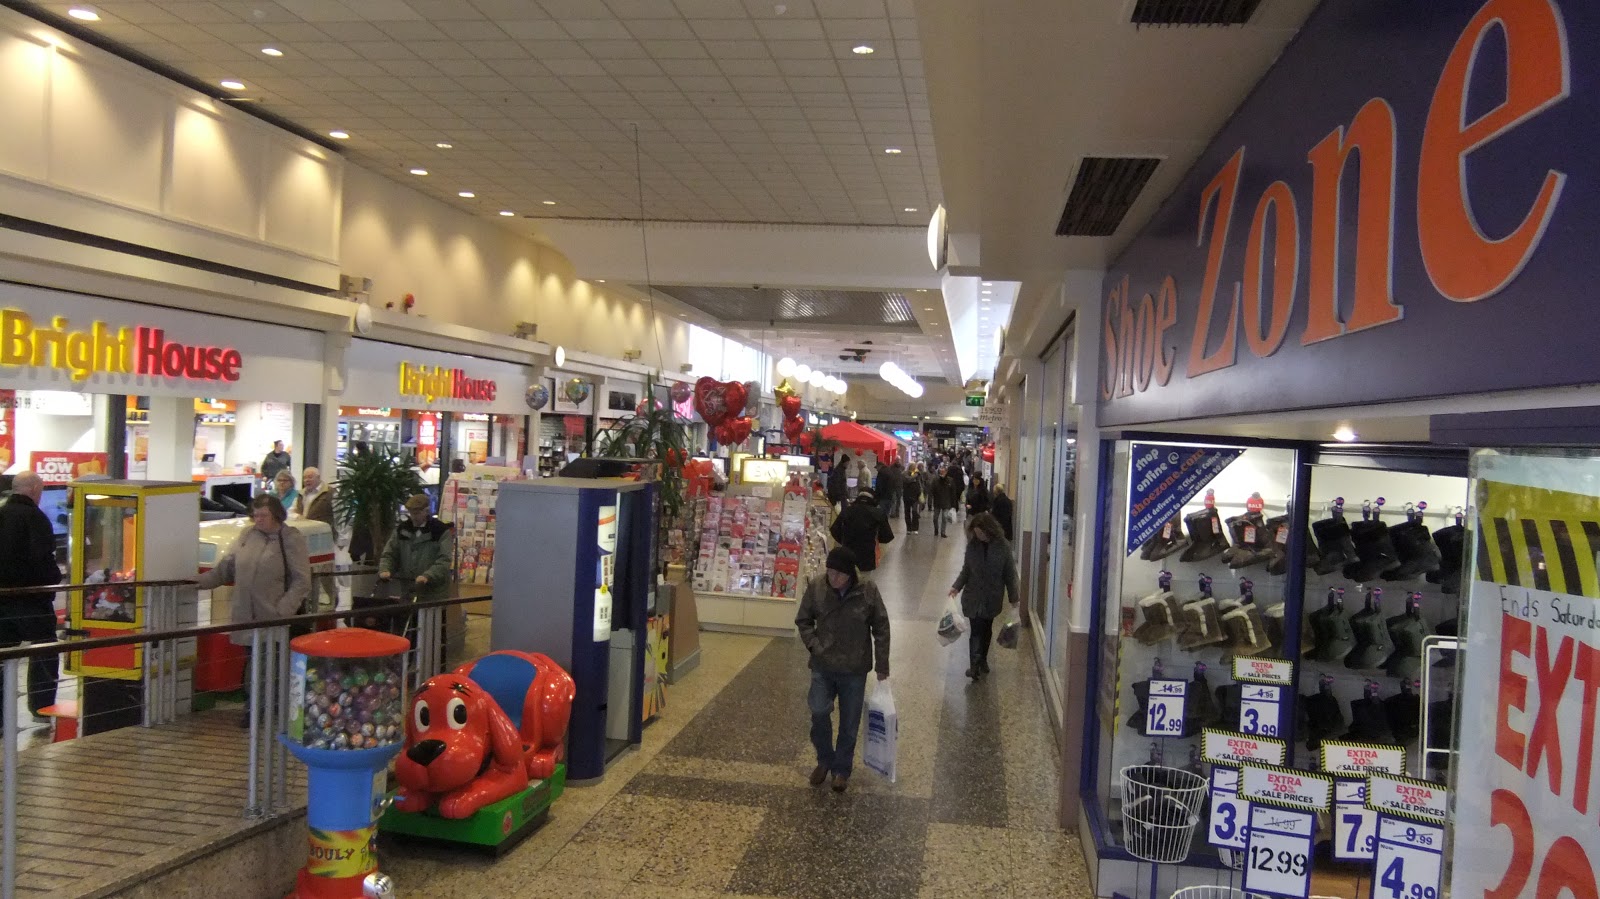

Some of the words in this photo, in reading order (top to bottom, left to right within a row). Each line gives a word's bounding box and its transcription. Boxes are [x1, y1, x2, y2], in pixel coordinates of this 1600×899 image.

[1102, 274, 1177, 400] Shoe
[1186, 0, 1570, 378] Zone
[36, 462, 74, 474] LOW
[1135, 448, 1159, 471] shop
[1131, 448, 1205, 517] shoezone.com
[1136, 462, 1168, 492] online
[1182, 475, 1197, 488] Click
[1138, 527, 1153, 542] FREE
[1153, 510, 1174, 529] returns
[1194, 472, 1214, 491] within
[1138, 512, 1152, 529] FREE
[1152, 493, 1176, 516] delivery
[1500, 586, 1539, 618] Ends
[1149, 703, 1182, 731] 12.99
[1228, 739, 1258, 750] EXTRA
[1347, 749, 1378, 758] EXTRA
[1268, 773, 1302, 786] EXTRA
[1262, 790, 1281, 799] SALE
[1284, 792, 1314, 803] PRICES
[1396, 785, 1432, 799] EXTRA
[1390, 800, 1411, 810] SALE
[1413, 805, 1445, 816] PRICES
[1406, 827, 1432, 845] 9.99
[1251, 845, 1308, 876] 12.99
[1381, 856, 1436, 899] 4.99
